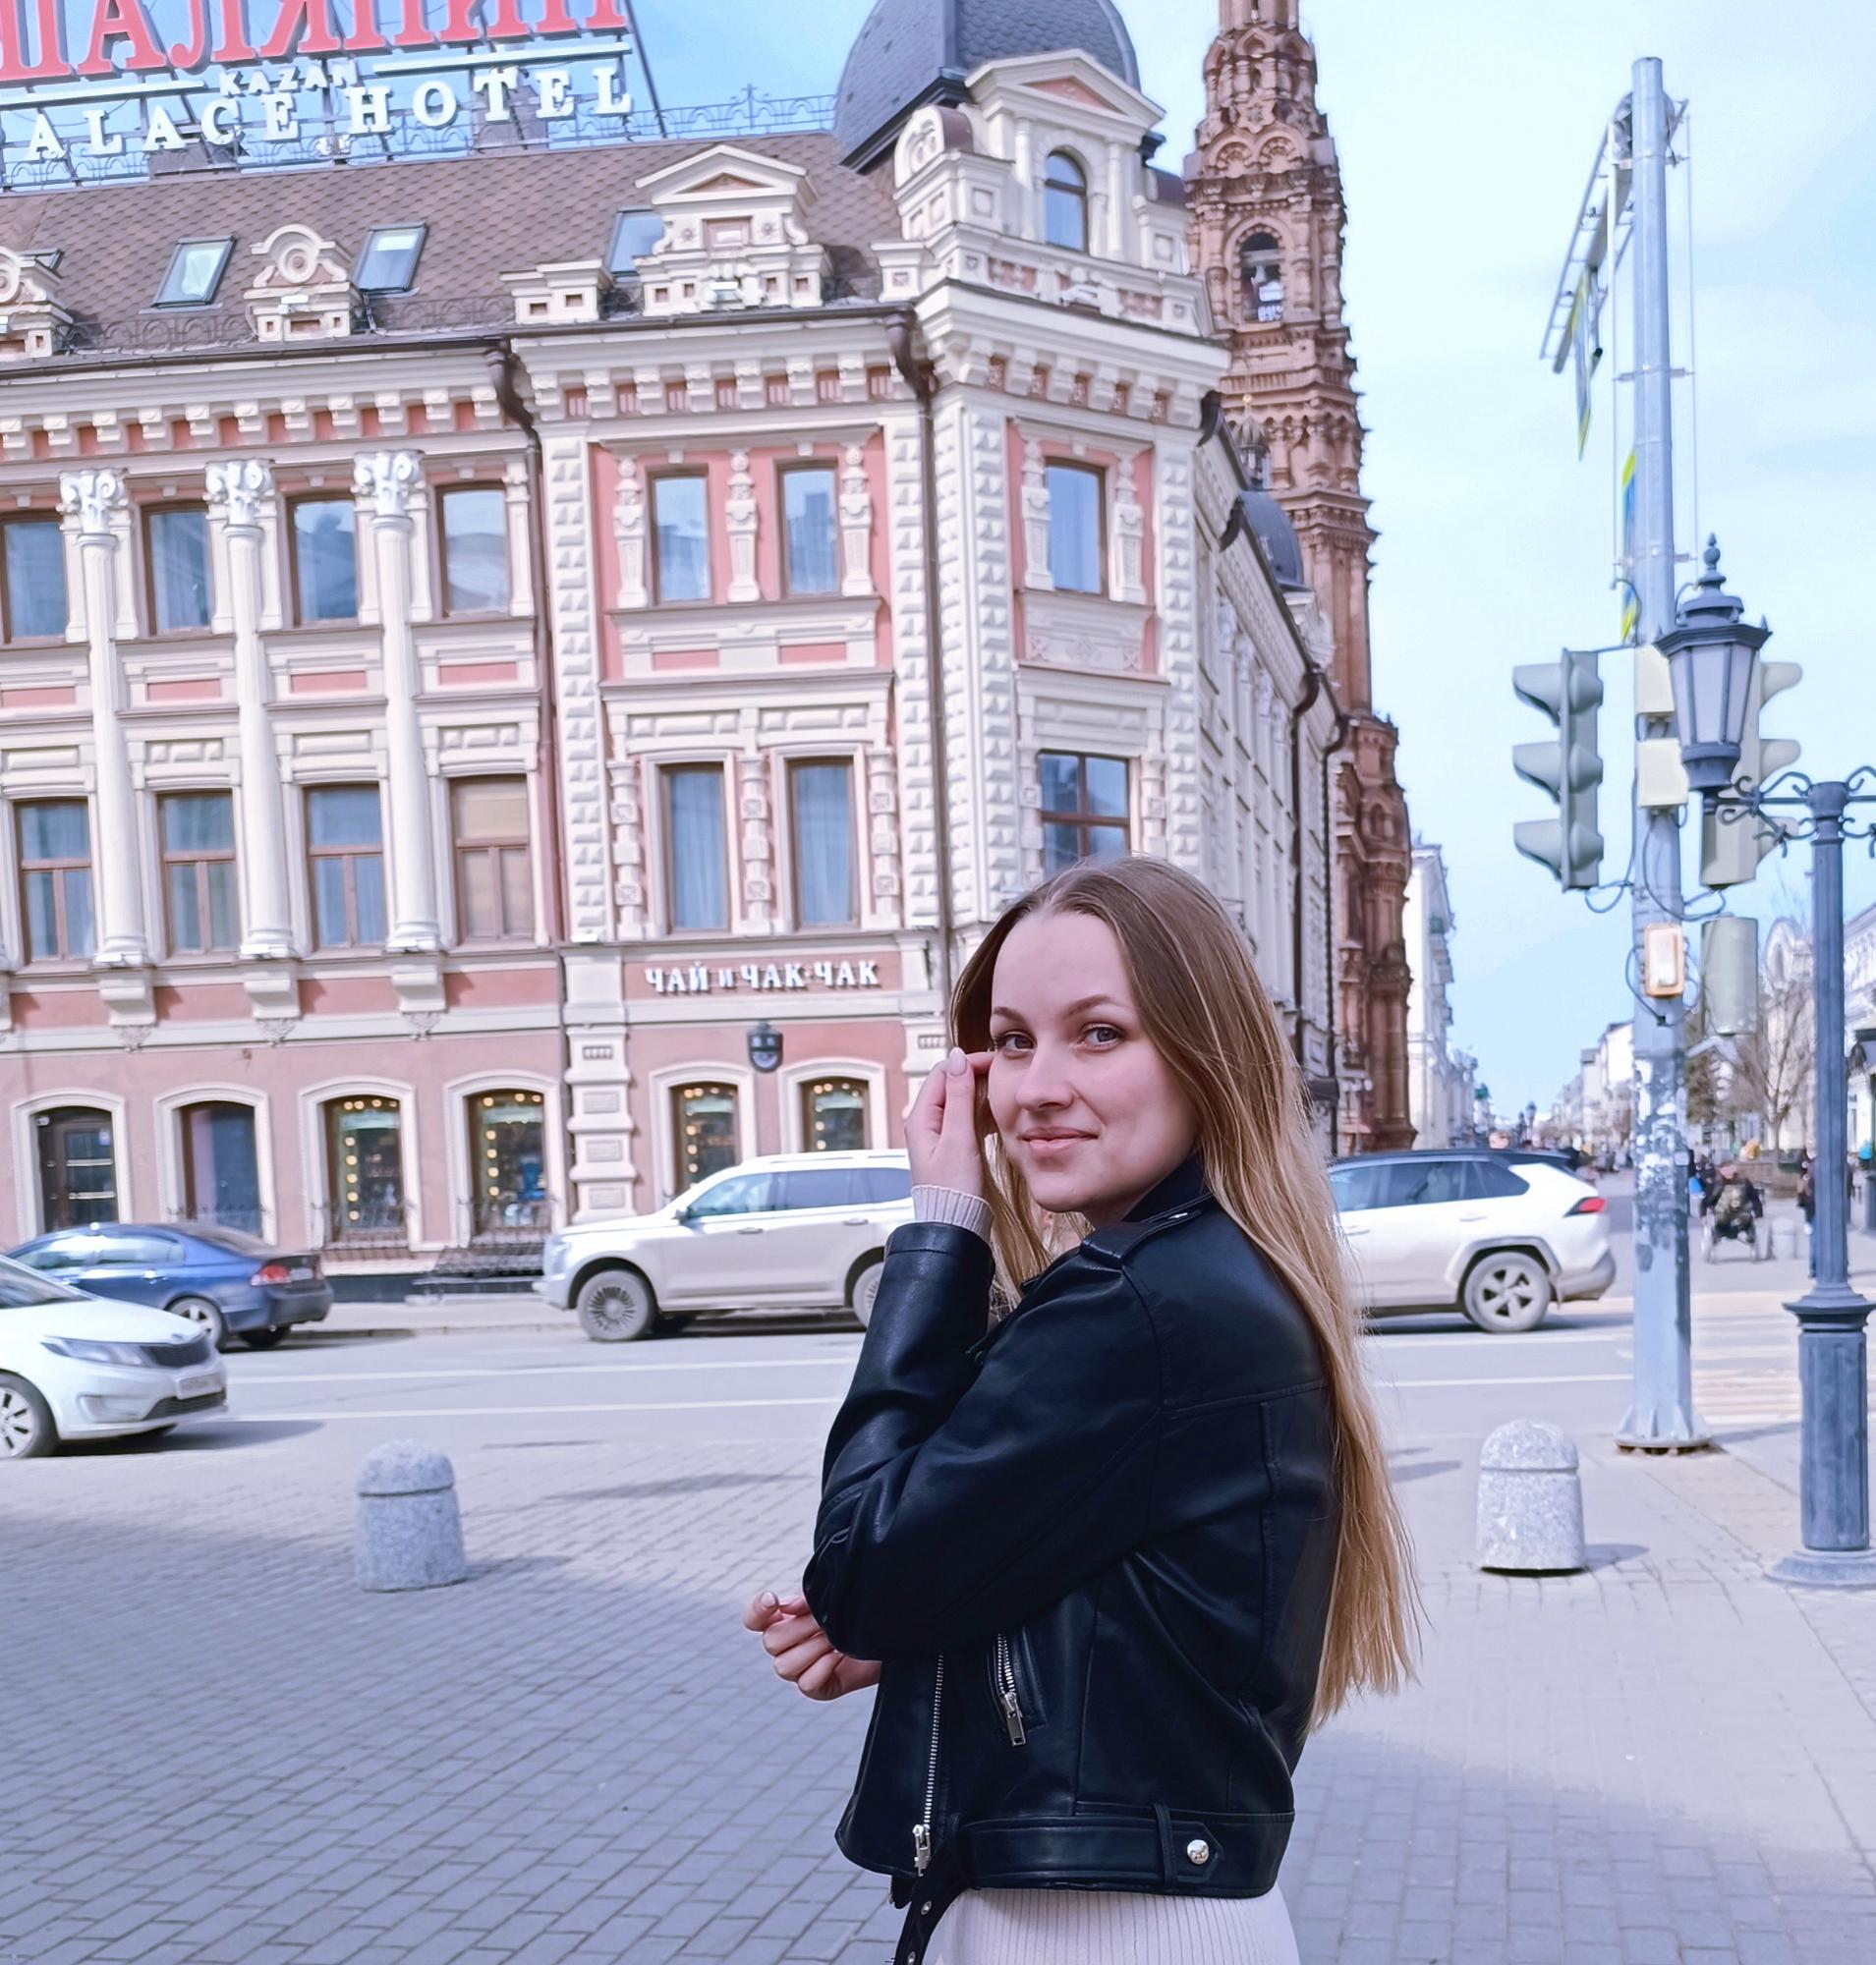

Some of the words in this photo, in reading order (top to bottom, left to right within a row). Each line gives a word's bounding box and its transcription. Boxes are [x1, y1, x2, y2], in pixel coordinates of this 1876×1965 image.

[218, 60, 358, 96] KAZAN
[0, 92, 300, 161] ALACE
[345, 66, 632, 134] HOTEL
[645, 961, 710, 992] ЧАЙ
